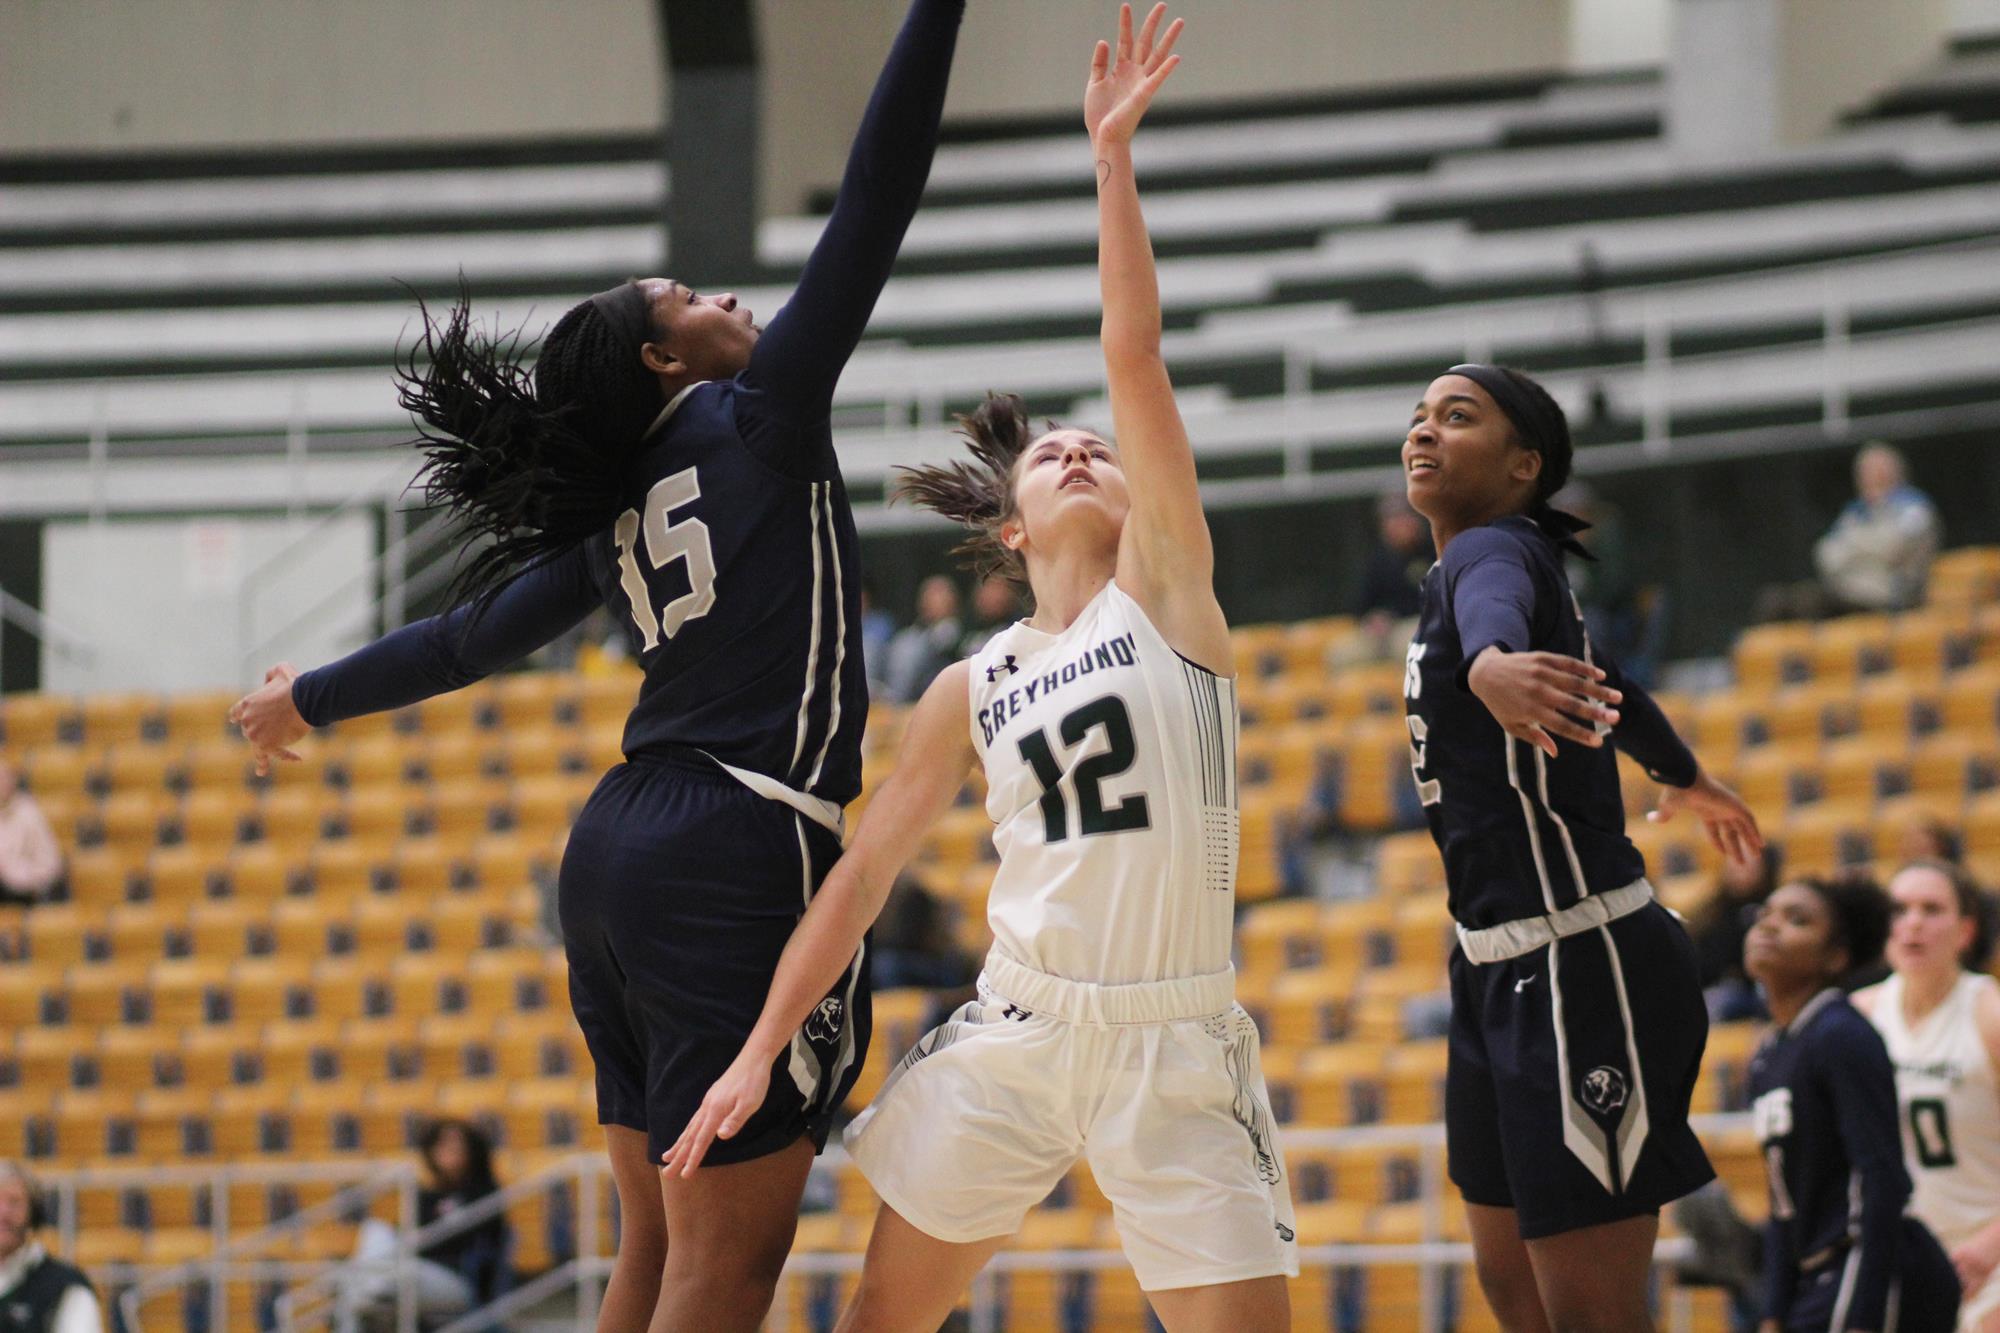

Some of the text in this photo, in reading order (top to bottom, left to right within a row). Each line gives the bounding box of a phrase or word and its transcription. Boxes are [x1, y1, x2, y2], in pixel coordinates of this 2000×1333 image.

[615, 465, 717, 653] 15
[1015, 692, 1152, 845] 12
[1909, 1097, 1957, 1168] 0
